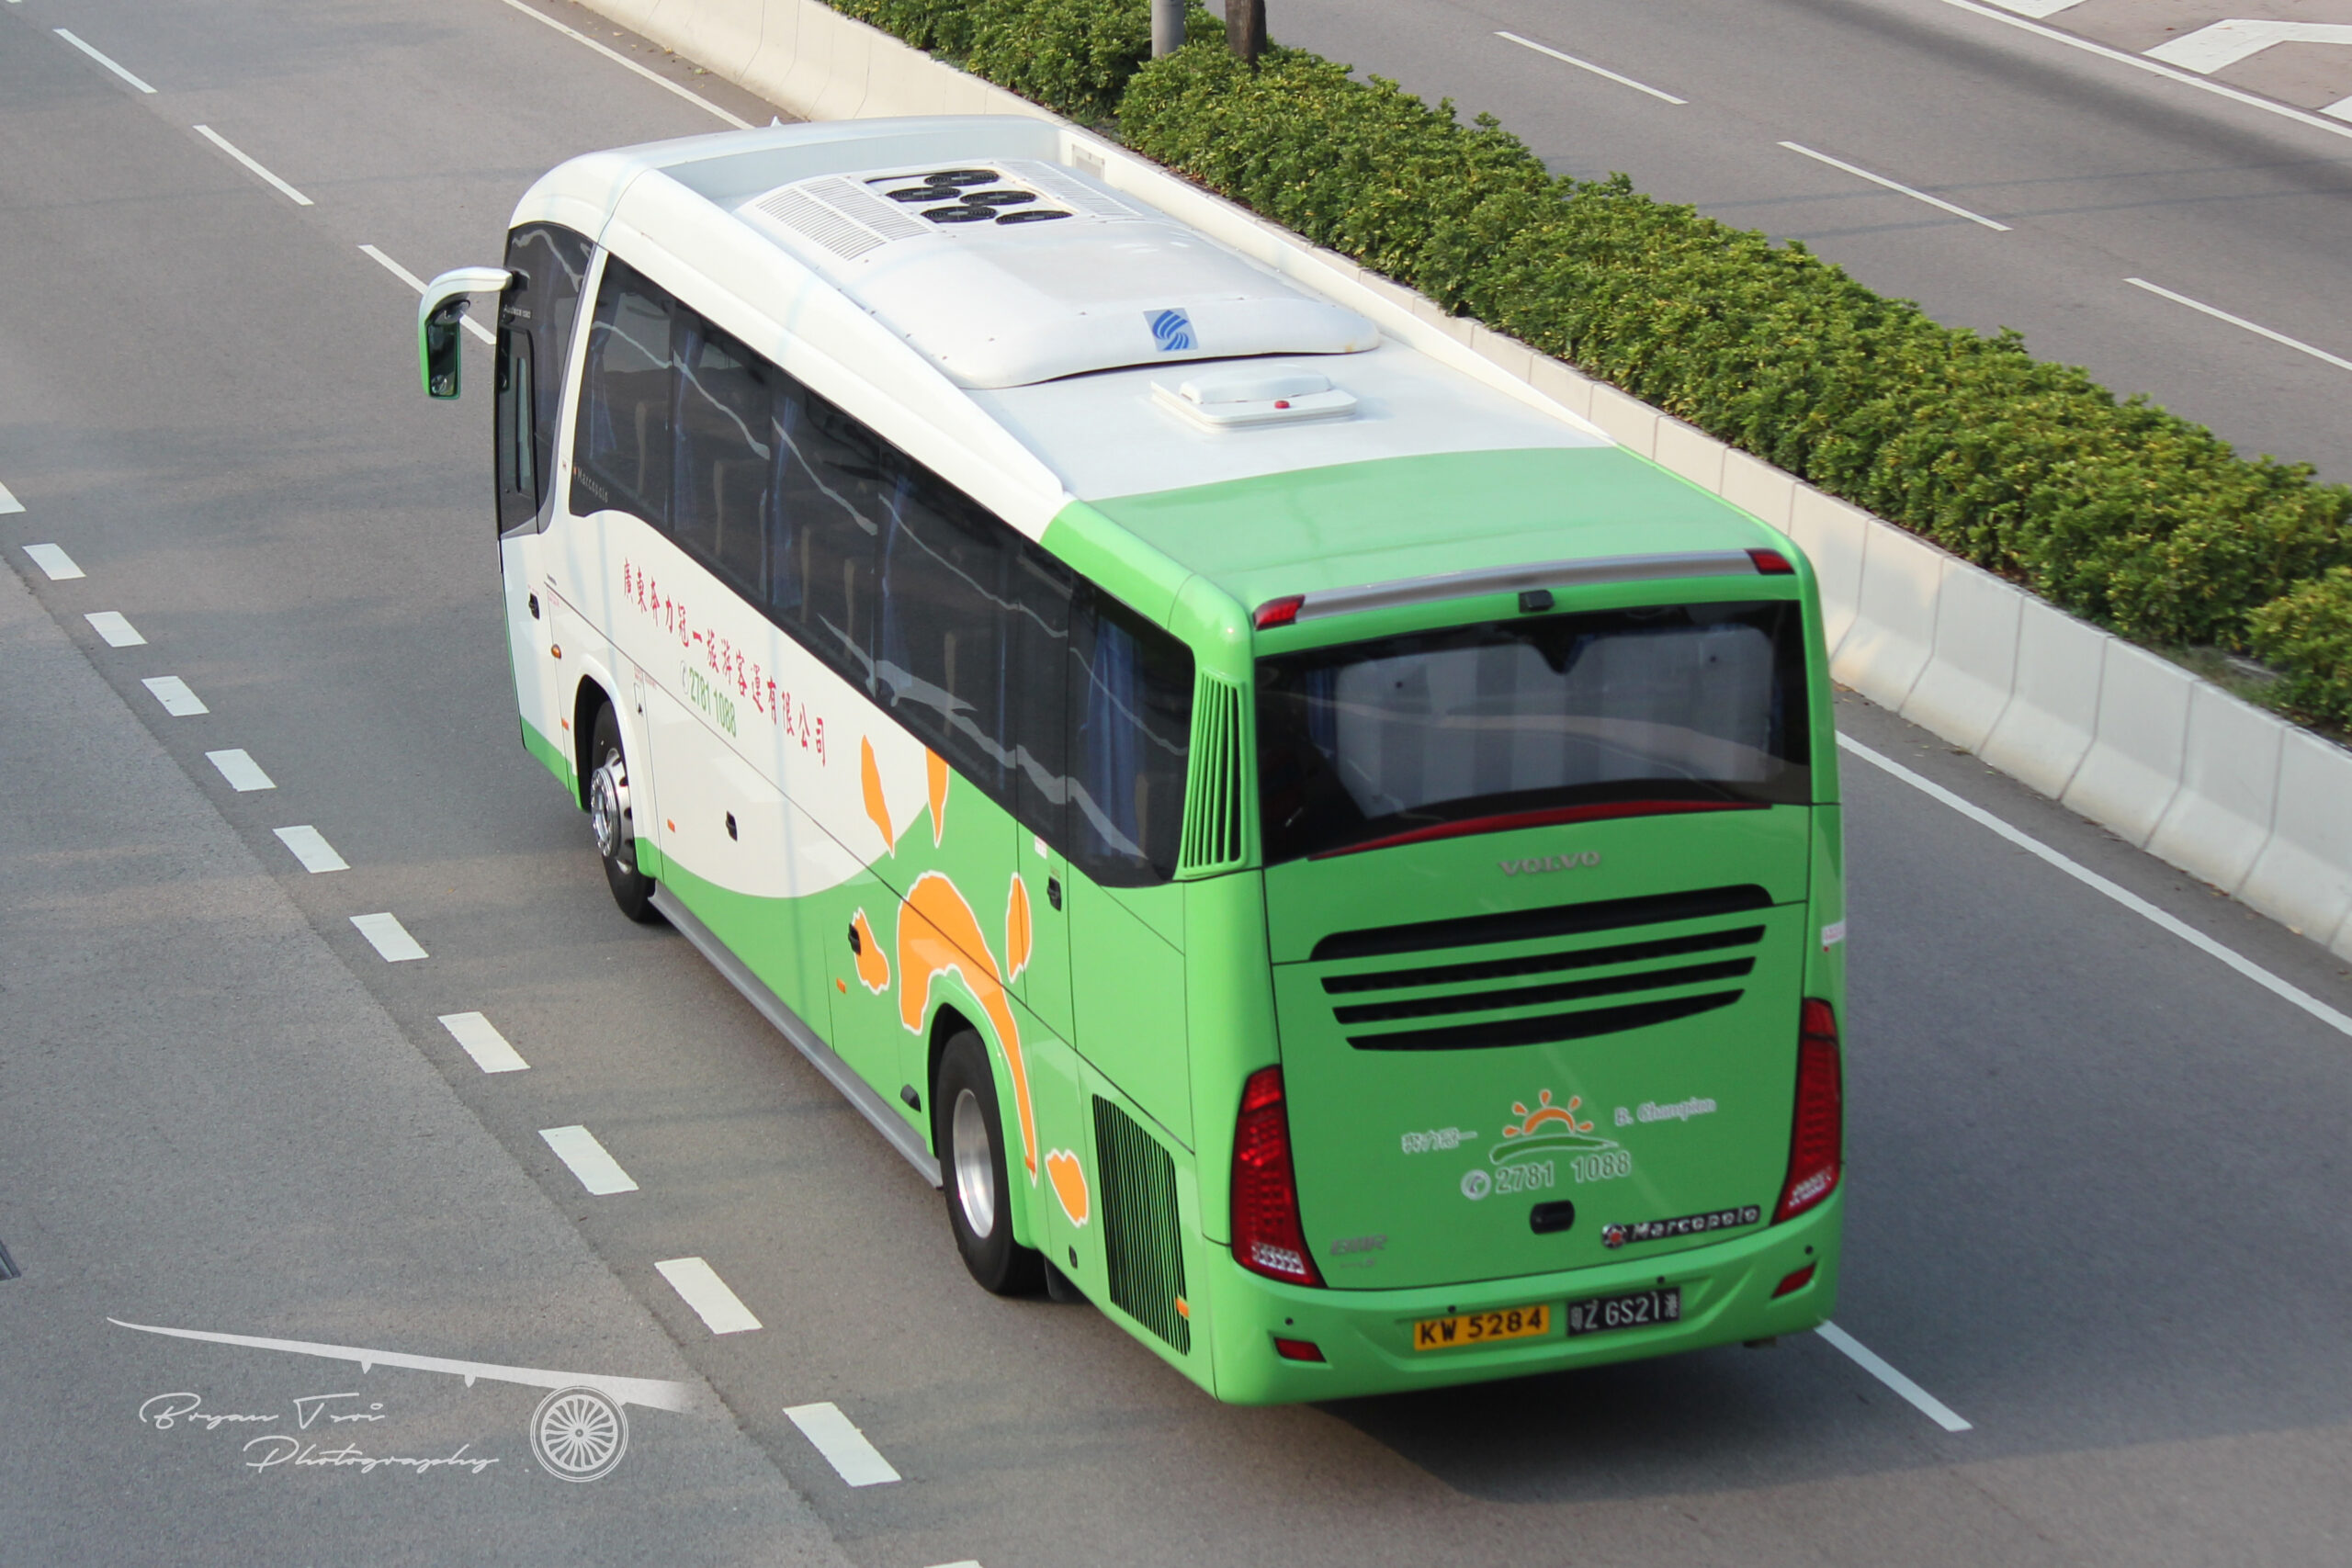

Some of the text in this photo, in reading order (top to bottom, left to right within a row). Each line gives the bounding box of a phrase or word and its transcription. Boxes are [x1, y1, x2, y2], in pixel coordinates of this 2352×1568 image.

[689, 667, 711, 716] 2781
[714, 688, 737, 739] 1088
[1498, 851, 1601, 876] VOLVO
[1495, 1149, 1632, 1194] 2781 1088
[1632, 1207, 1758, 1241] Marcopolo
[1420, 1307, 1542, 1345] KW 5284
